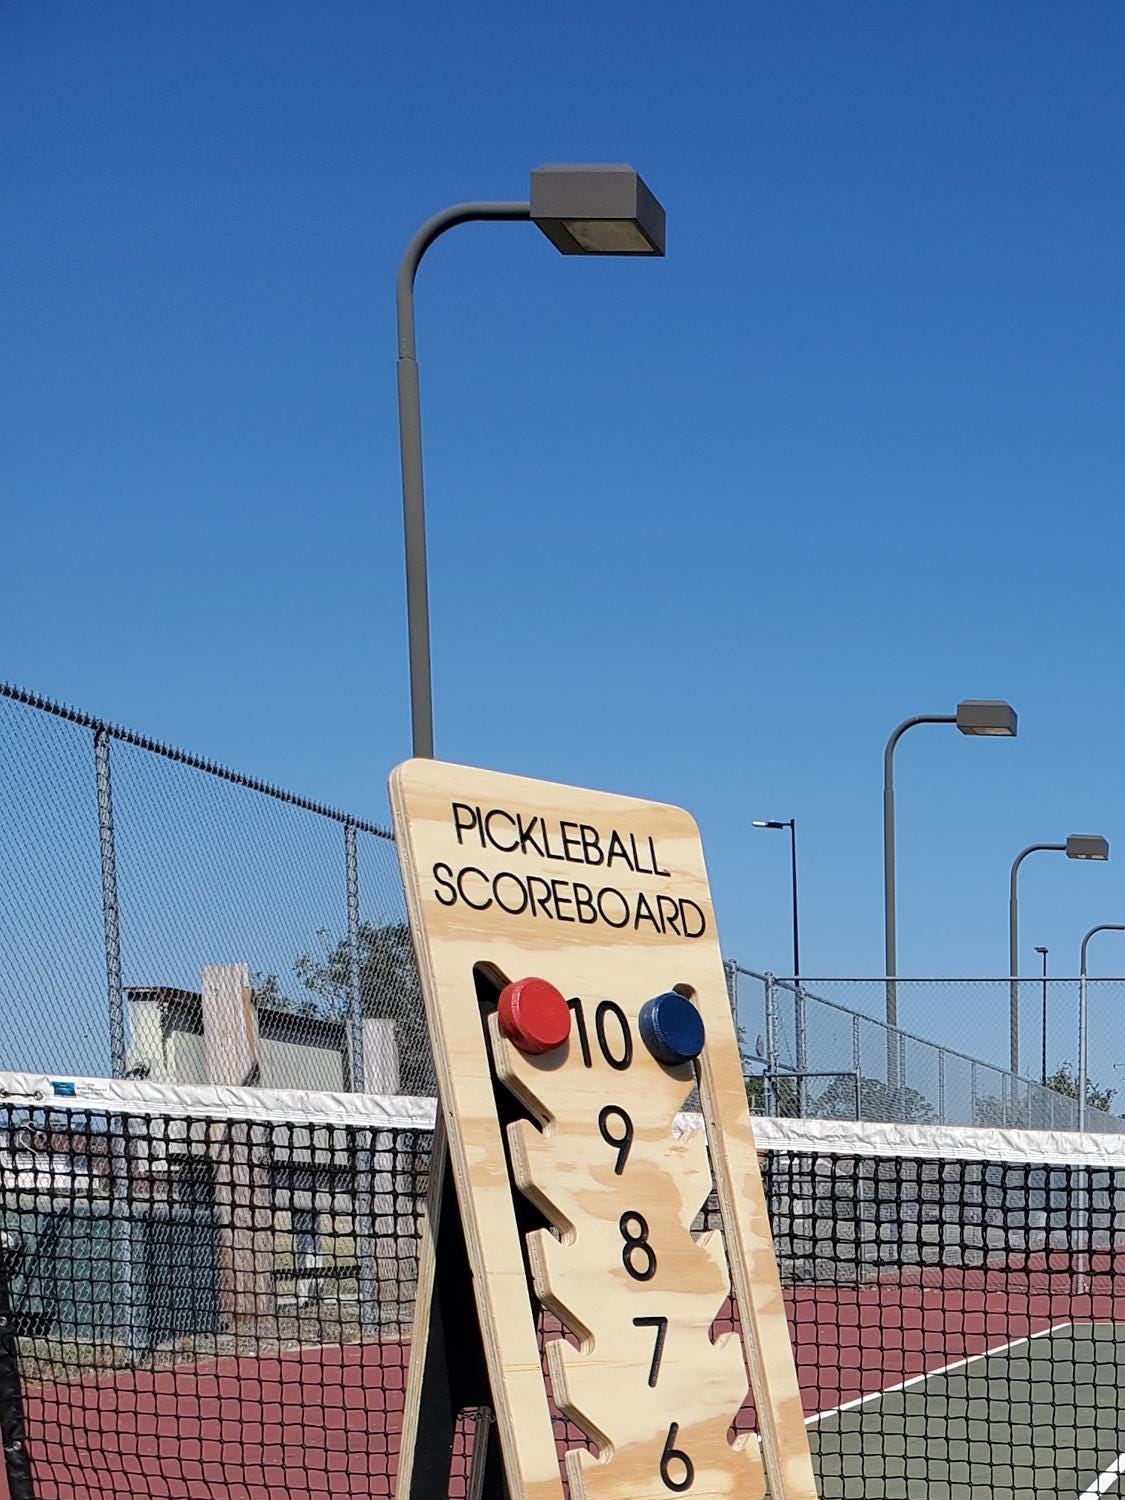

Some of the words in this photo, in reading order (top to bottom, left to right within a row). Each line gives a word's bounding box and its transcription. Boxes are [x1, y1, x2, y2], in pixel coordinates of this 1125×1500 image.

[451, 802, 671, 878] PICKLEBALL
[432, 862, 707, 939] SCOREBOARD
[567, 997, 633, 1071] 10
[598, 1104, 634, 1176] 9
[619, 1210, 658, 1282] 8
[632, 1316, 668, 1388] 7
[659, 1421, 695, 1493] 6
